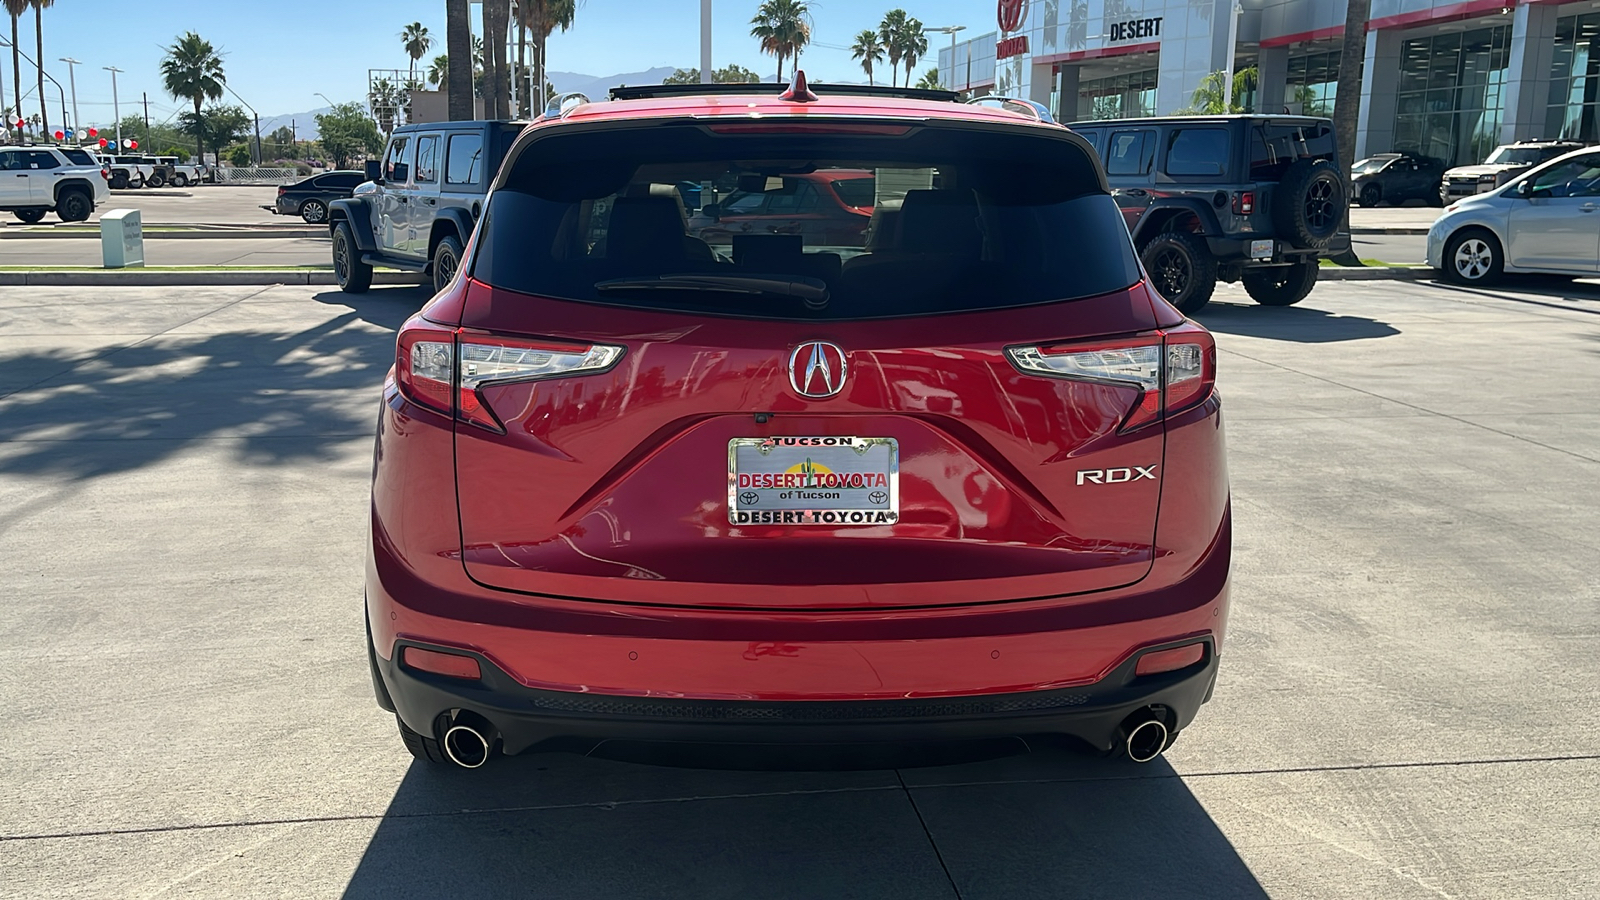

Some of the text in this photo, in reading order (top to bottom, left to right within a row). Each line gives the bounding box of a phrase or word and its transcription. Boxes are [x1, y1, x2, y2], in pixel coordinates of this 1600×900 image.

[1110, 17, 1163, 41] DESERT
[997, 36, 1025, 60] TOYOTA
[773, 437, 852, 446] TUCSON
[739, 474, 888, 488] DESERT TOYOTA
[1076, 465, 1157, 485] RDX
[779, 490, 840, 500] of Tucson
[737, 512, 886, 524] DESERT TOYOTA
